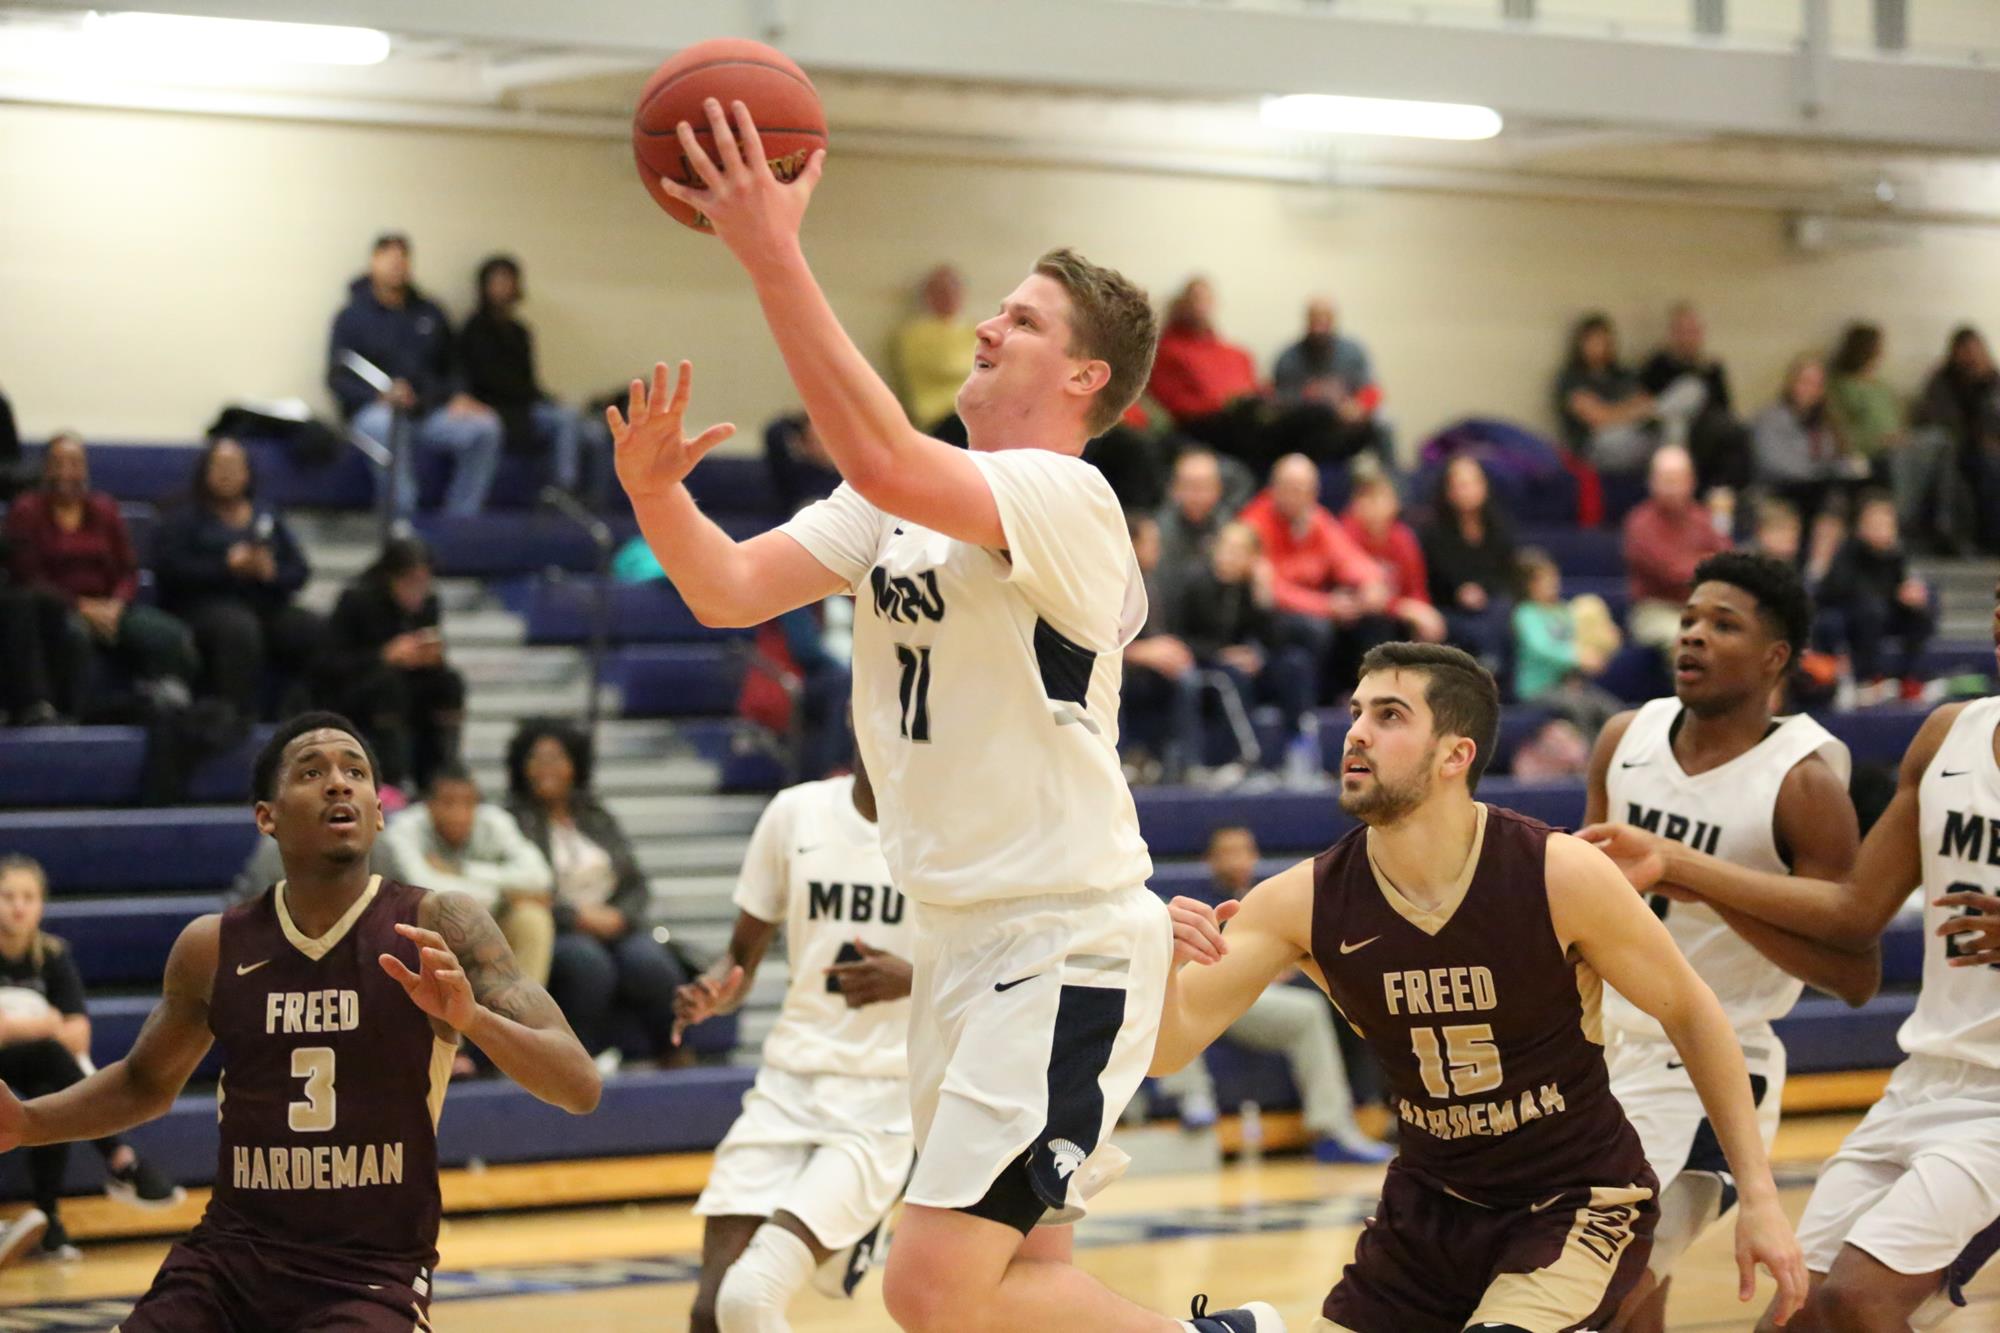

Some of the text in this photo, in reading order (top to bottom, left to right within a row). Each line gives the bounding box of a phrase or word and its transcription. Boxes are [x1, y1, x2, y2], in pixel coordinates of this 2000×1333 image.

[871, 566, 945, 623] MBU
[894, 642, 932, 744] 11
[808, 881, 905, 924] MBU
[266, 989, 360, 1034] FREED
[1383, 966, 1498, 1015] FREED
[1410, 1023, 1504, 1099] 15
[288, 1047, 336, 1132] 3
[233, 1142, 403, 1190] HARDEMAN
